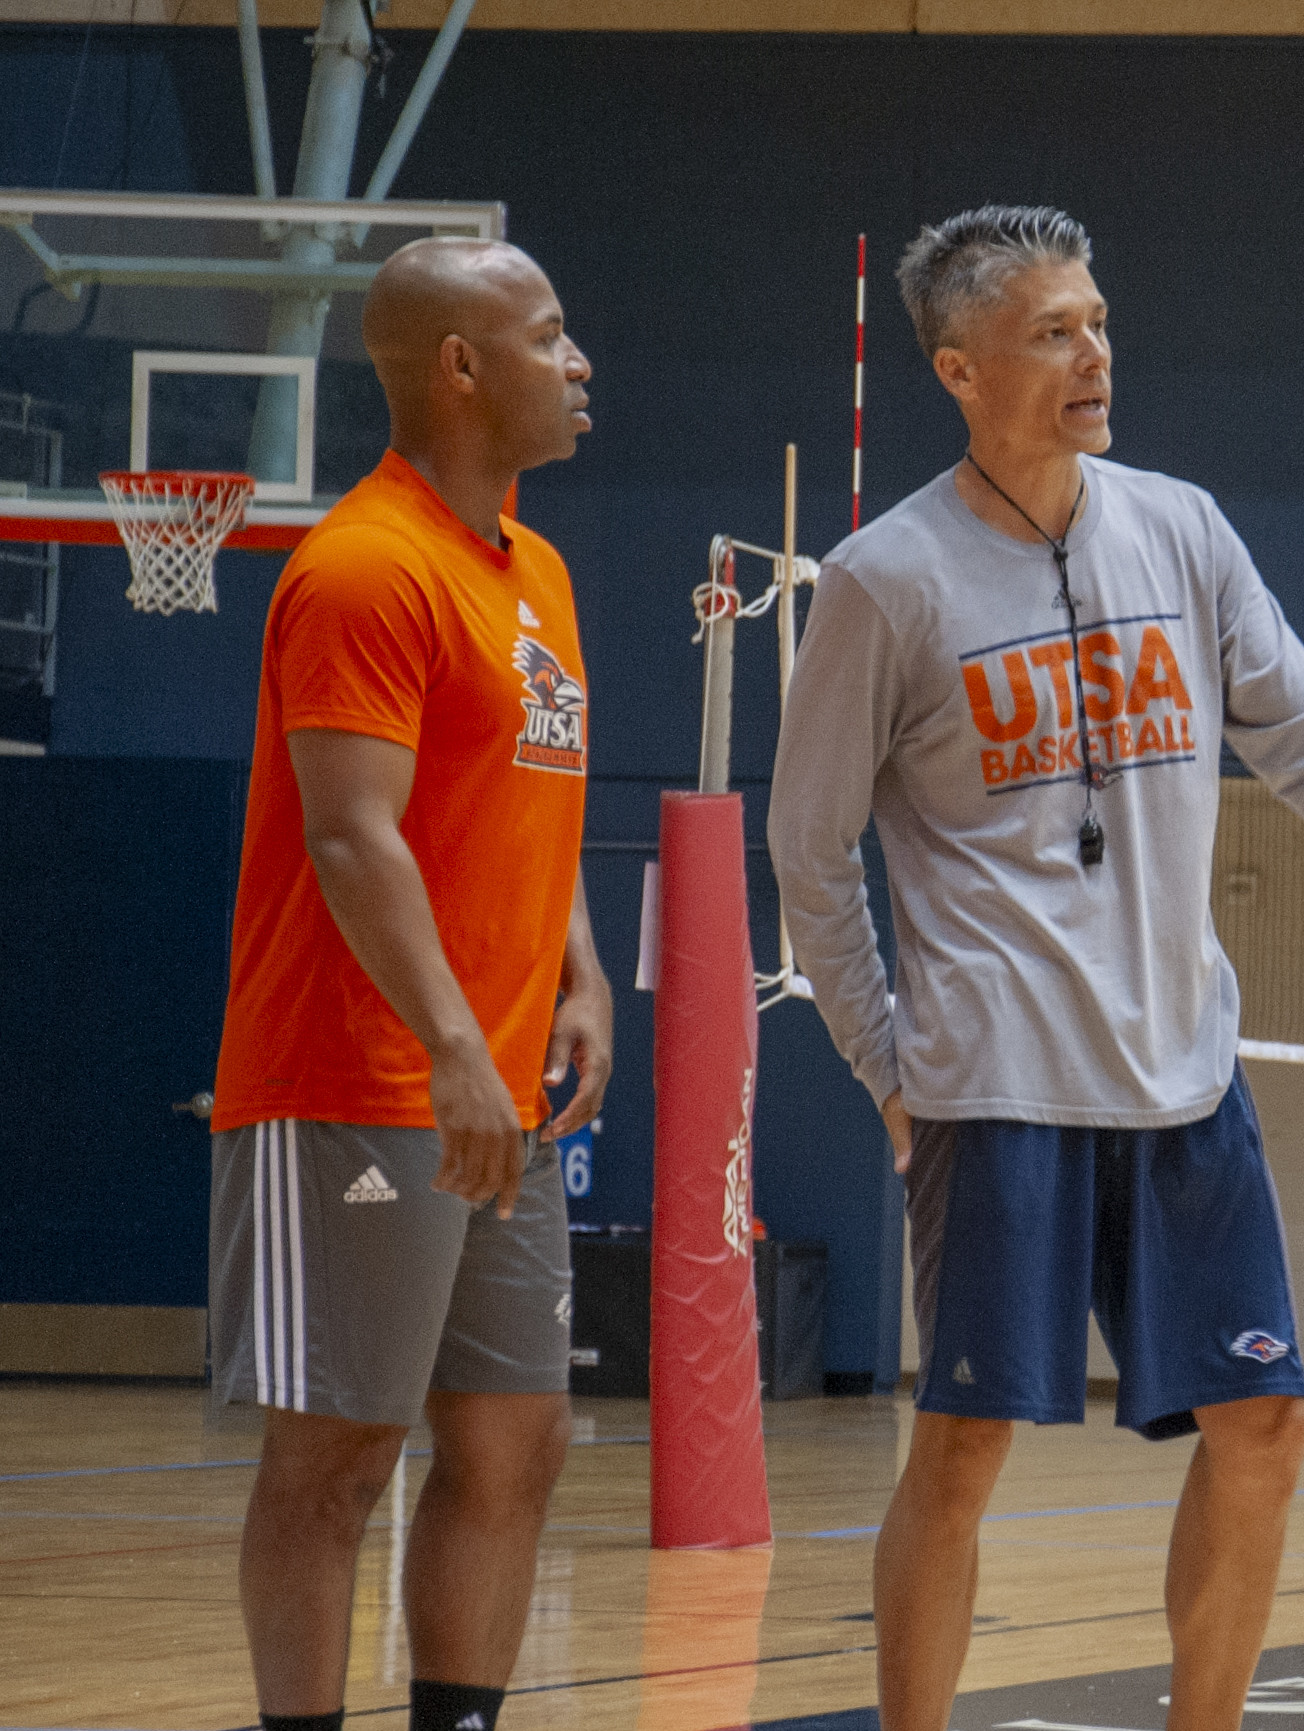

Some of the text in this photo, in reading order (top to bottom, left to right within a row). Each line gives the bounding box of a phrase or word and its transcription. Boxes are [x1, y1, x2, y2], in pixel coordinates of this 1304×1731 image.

[961, 625, 1194, 743] UTSA
[526, 706, 581, 749] UTSA
[979, 714, 1196, 786] BASKETBALL
[343, 1187, 399, 1203] adidas
[565, 1145, 590, 1197] 6
